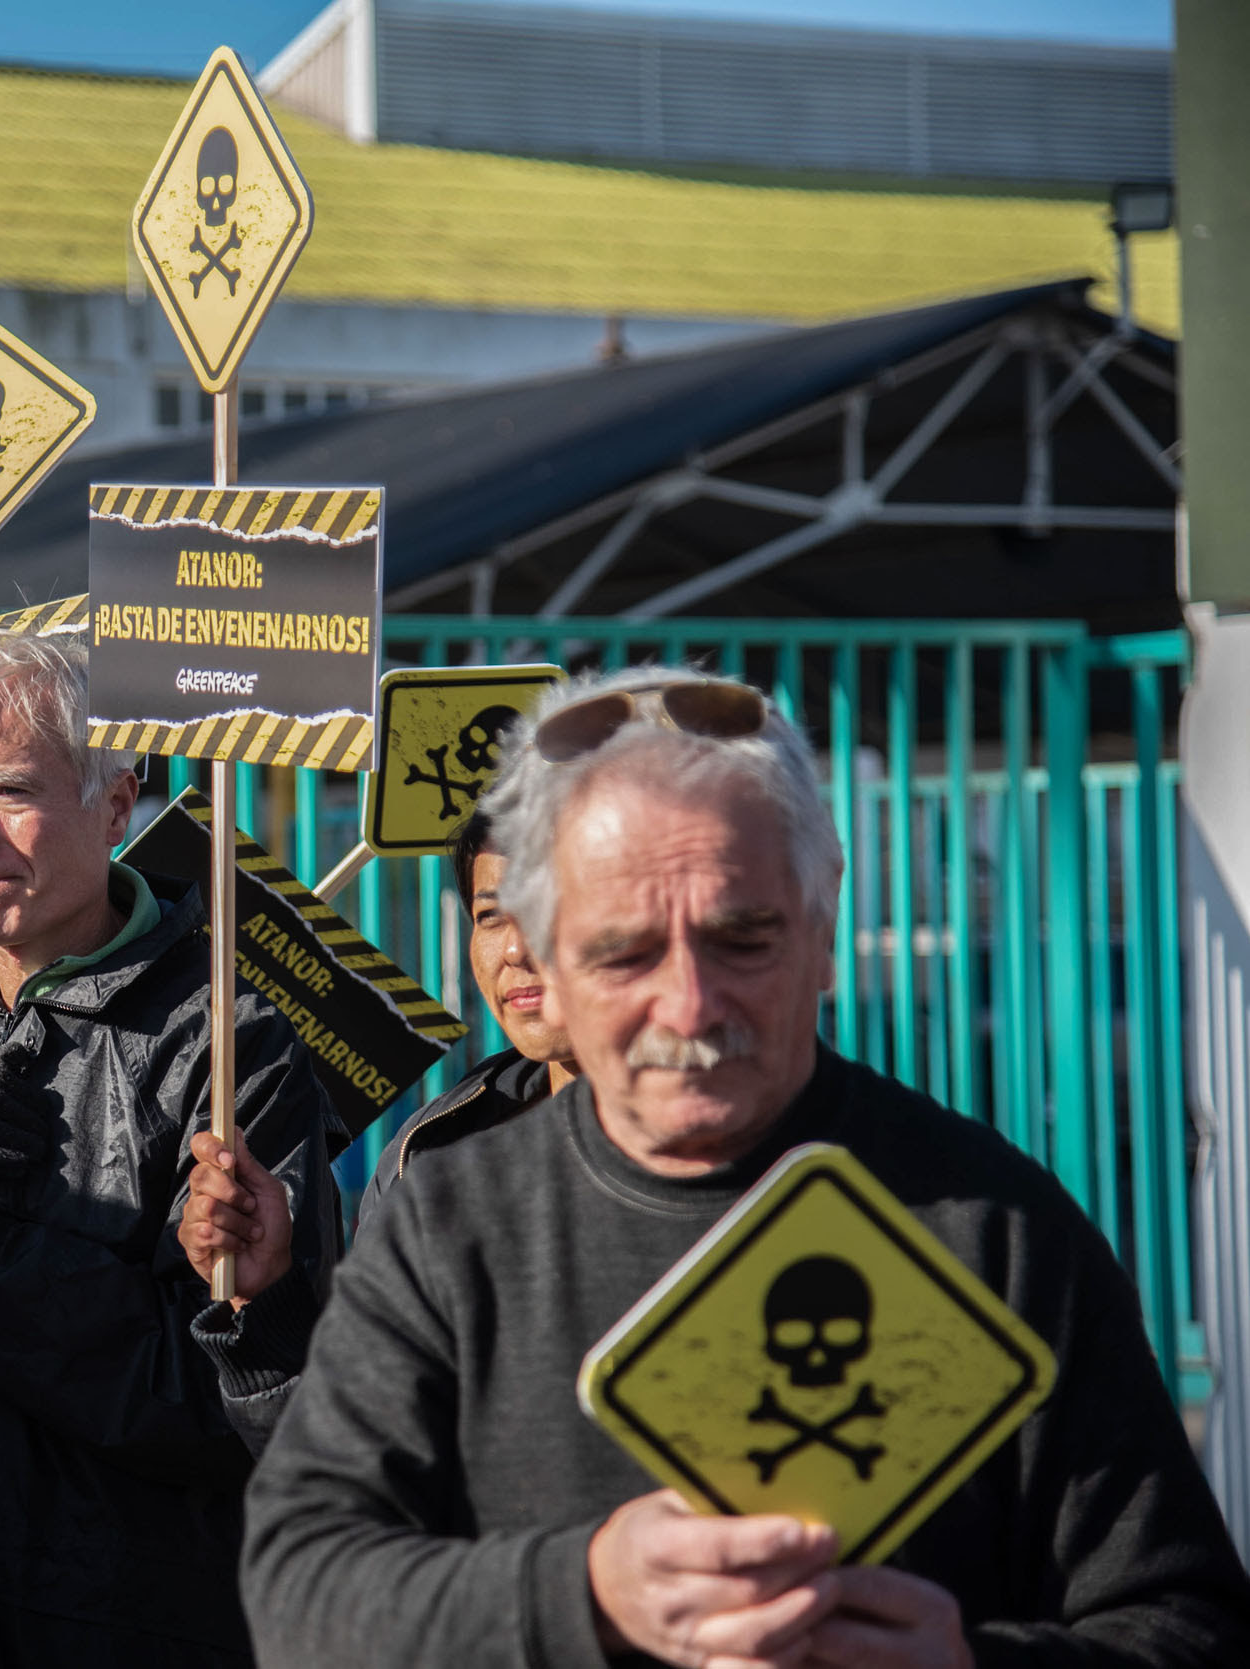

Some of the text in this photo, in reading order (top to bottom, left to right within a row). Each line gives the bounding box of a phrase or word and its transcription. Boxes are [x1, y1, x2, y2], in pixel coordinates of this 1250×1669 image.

[176, 550, 263, 588] ATANOR:
[94, 604, 370, 655] ¡BASTA DE ENVENENARNOS!
[176, 668, 258, 695] GREENPEACE
[239, 912, 337, 999] ATANOR:
